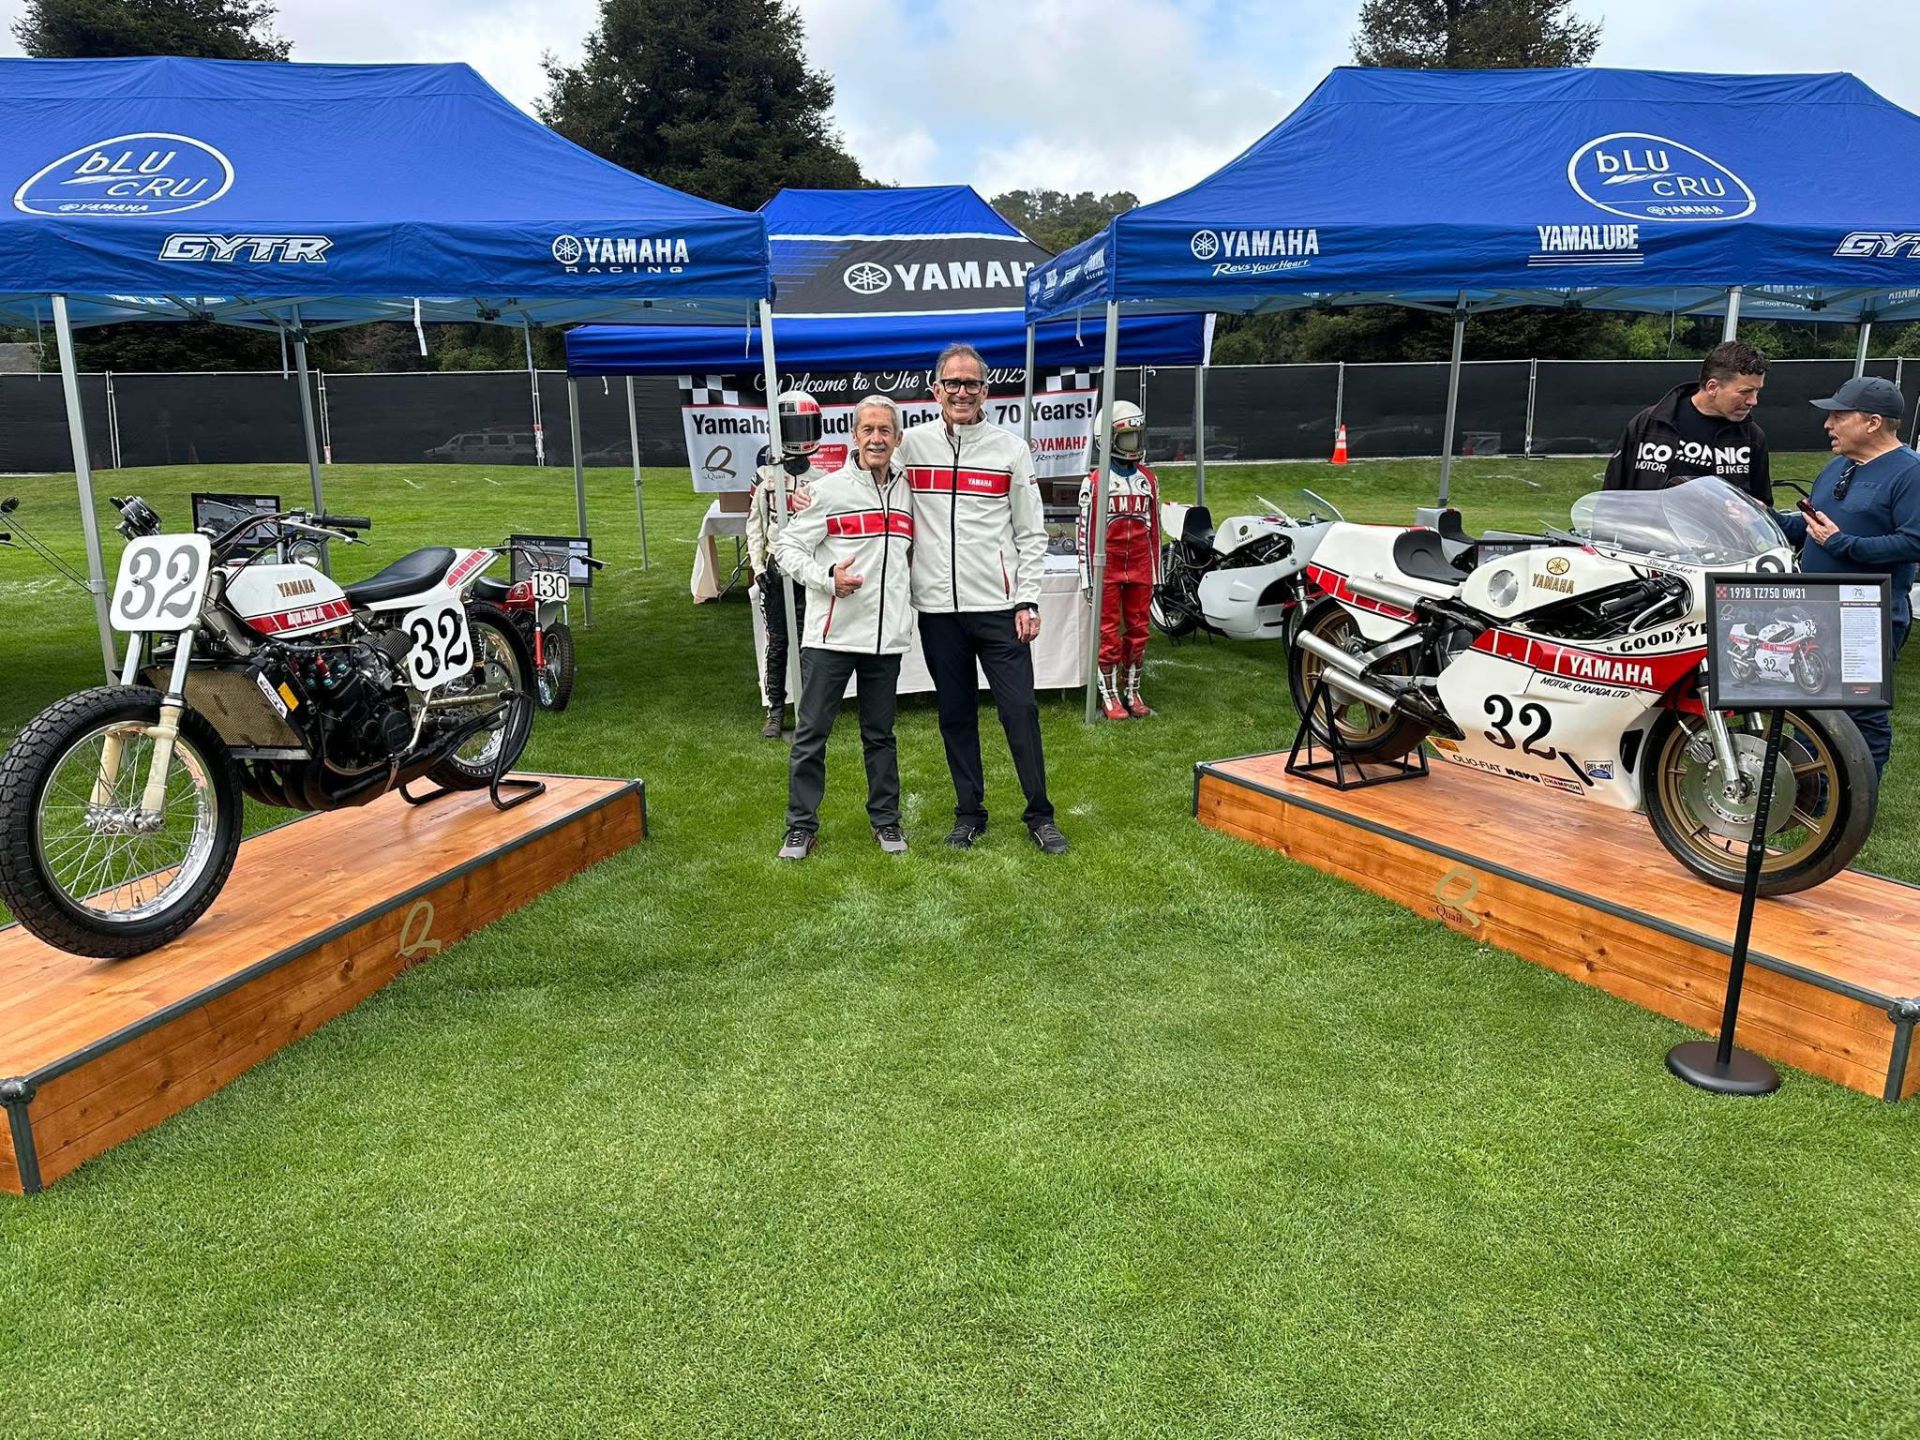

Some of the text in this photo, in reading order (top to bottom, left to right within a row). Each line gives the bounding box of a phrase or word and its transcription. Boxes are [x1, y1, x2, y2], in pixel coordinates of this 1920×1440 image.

[78, 203, 149, 212] YAMAHA
[1664, 205, 1725, 216] YAMAHA
[158, 233, 334, 264] GYTR
[583, 237, 690, 265] YAMAHA
[1220, 228, 1320, 257] YAMAHA
[1537, 224, 1639, 251] YAMALUBE
[1833, 231, 1920, 258] GYT
[565, 265, 684, 274] RACING
[893, 260, 1035, 291] YAMAH
[753, 372, 848, 395] Welcome
[852, 371, 871, 390] to
[994, 404, 1021, 425] 70
[1031, 398, 1093, 422] Years!
[1635, 461, 1667, 473] MOTOR
[1716, 465, 1750, 475] BIKES
[967, 477, 993, 488] YAMAHA
[120, 545, 200, 620] 32
[276, 578, 317, 598] YAMAHA
[534, 573, 568, 600] 130
[1531, 573, 1575, 595] YAMAHA
[1730, 587, 1751, 600] 1978
[1753, 586, 1780, 600] TZ750
[410, 608, 470, 681] 32
[1619, 621, 1709, 653] GOODYE
[1569, 654, 1654, 686] YAMAHA
[1540, 677, 1631, 698] MOTOR CANADA LTD
[1483, 693, 1558, 760] 32
[1453, 754, 1501, 773] OLIO-FIAT
